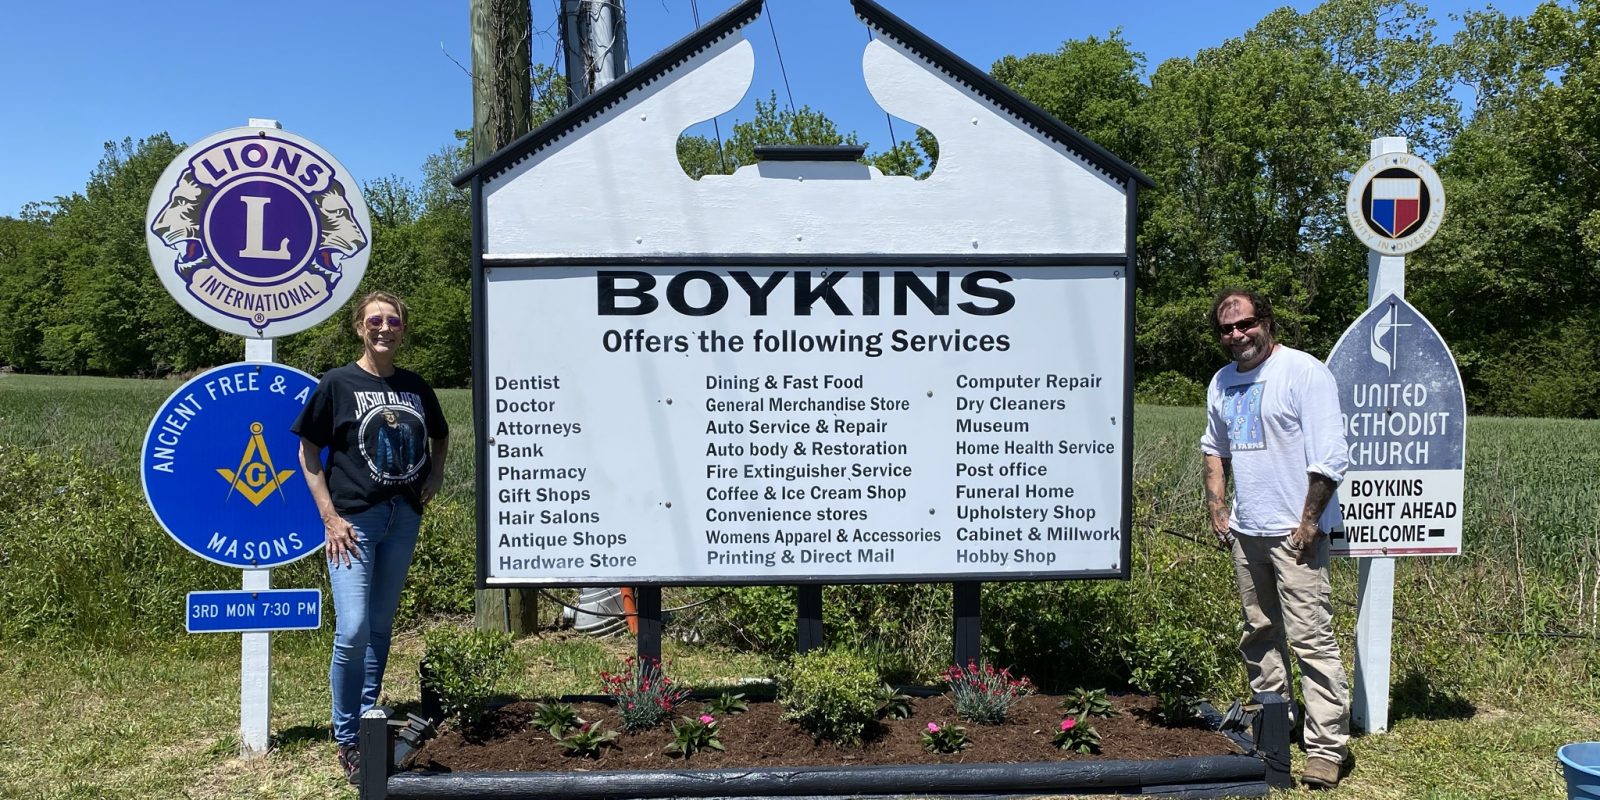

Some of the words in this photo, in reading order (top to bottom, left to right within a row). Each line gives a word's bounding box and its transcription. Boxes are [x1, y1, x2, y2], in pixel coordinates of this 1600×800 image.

[201, 143, 324, 187] LIONS
[239, 195, 291, 260] L
[1351, 210, 1374, 241] UNITY
[1377, 242, 1390, 250] IN
[1396, 209, 1441, 251] DIVERSITY
[200, 275, 320, 312] INTERNATIONAL
[596, 270, 1017, 317] BOYKINS
[602, 329, 689, 353] Offers
[698, 329, 746, 352] the
[753, 329, 884, 357] following
[891, 328, 1011, 353] Services
[496, 375, 561, 390] Dentist
[706, 376, 760, 392] Dining
[765, 376, 778, 389] &
[783, 376, 819, 389] Fast
[824, 375, 864, 389] Food
[956, 375, 1041, 391] Computer
[1047, 374, 1102, 391] Repair
[706, 397, 764, 411] General
[769, 397, 866, 411] Merchandise
[871, 396, 910, 411] Store
[1353, 383, 1427, 408] UNITED
[354, 391, 387, 420] JASON
[496, 399, 556, 413] Doctor
[956, 397, 985, 413] Dry
[990, 397, 1066, 411] Cleaners
[153, 393, 203, 473] ANCIENT
[205, 372, 260, 400] FREE
[270, 375, 287, 395] &
[496, 421, 582, 437] Attorneys
[706, 420, 744, 434] Auto
[749, 419, 811, 434] Service
[816, 420, 829, 433] &
[834, 419, 888, 436] Repair
[956, 419, 1029, 433] Museum
[498, 443, 544, 458] Bank
[706, 442, 744, 456] Auto
[750, 442, 789, 459] body
[794, 442, 807, 456] &
[812, 441, 907, 456] Restoration
[956, 441, 1000, 455] Home
[1005, 441, 1054, 454] Health
[1058, 440, 1115, 454] Service
[1348, 441, 1429, 466] CHURCH
[498, 467, 587, 481] Pharmacy
[706, 465, 738, 478] Fire
[744, 464, 847, 481] Extinguisher
[851, 463, 912, 477] Service
[956, 462, 994, 477] Post
[999, 462, 1048, 477] office
[498, 488, 532, 503] Gift
[536, 488, 591, 504] Shops
[706, 486, 759, 501] Coffee
[764, 487, 777, 500] &
[782, 486, 806, 500] Ice
[811, 485, 862, 500] Cream
[866, 485, 907, 501] Shop
[956, 484, 1020, 499] Funeral
[1026, 484, 1075, 498] Home
[1351, 479, 1424, 498] BOYKINS
[498, 511, 535, 525] Hair
[540, 510, 600, 525] Salons
[706, 507, 812, 522] Convenience
[817, 508, 868, 521] stores
[957, 505, 1049, 522] Upholstery
[1053, 505, 1096, 520] Shop
[1340, 502, 1395, 520] RAIGHT
[1400, 501, 1457, 519] AHEAD
[498, 533, 568, 549] Antique
[573, 532, 627, 548] Shops
[706, 530, 770, 544] Womens
[774, 529, 832, 546] Apparel
[836, 529, 849, 543] &
[852, 528, 942, 543] Accessories
[956, 527, 1023, 541] Cabinet
[1028, 527, 1042, 541] &
[1047, 526, 1121, 541] Millwork
[1345, 525, 1426, 543] WELCOME
[207, 532, 304, 560] MASONS
[499, 555, 585, 570] Hardware
[590, 554, 637, 568] Store
[707, 550, 776, 566] Printing
[781, 549, 795, 563] &
[800, 550, 852, 564] Direct
[857, 549, 895, 563] Mail
[956, 549, 1009, 566] Hobby
[1013, 549, 1057, 565] Shop
[192, 604, 219, 618] 3RD
[226, 604, 255, 617] MON
[262, 602, 291, 616] 7:30
[298, 602, 316, 615] PM
